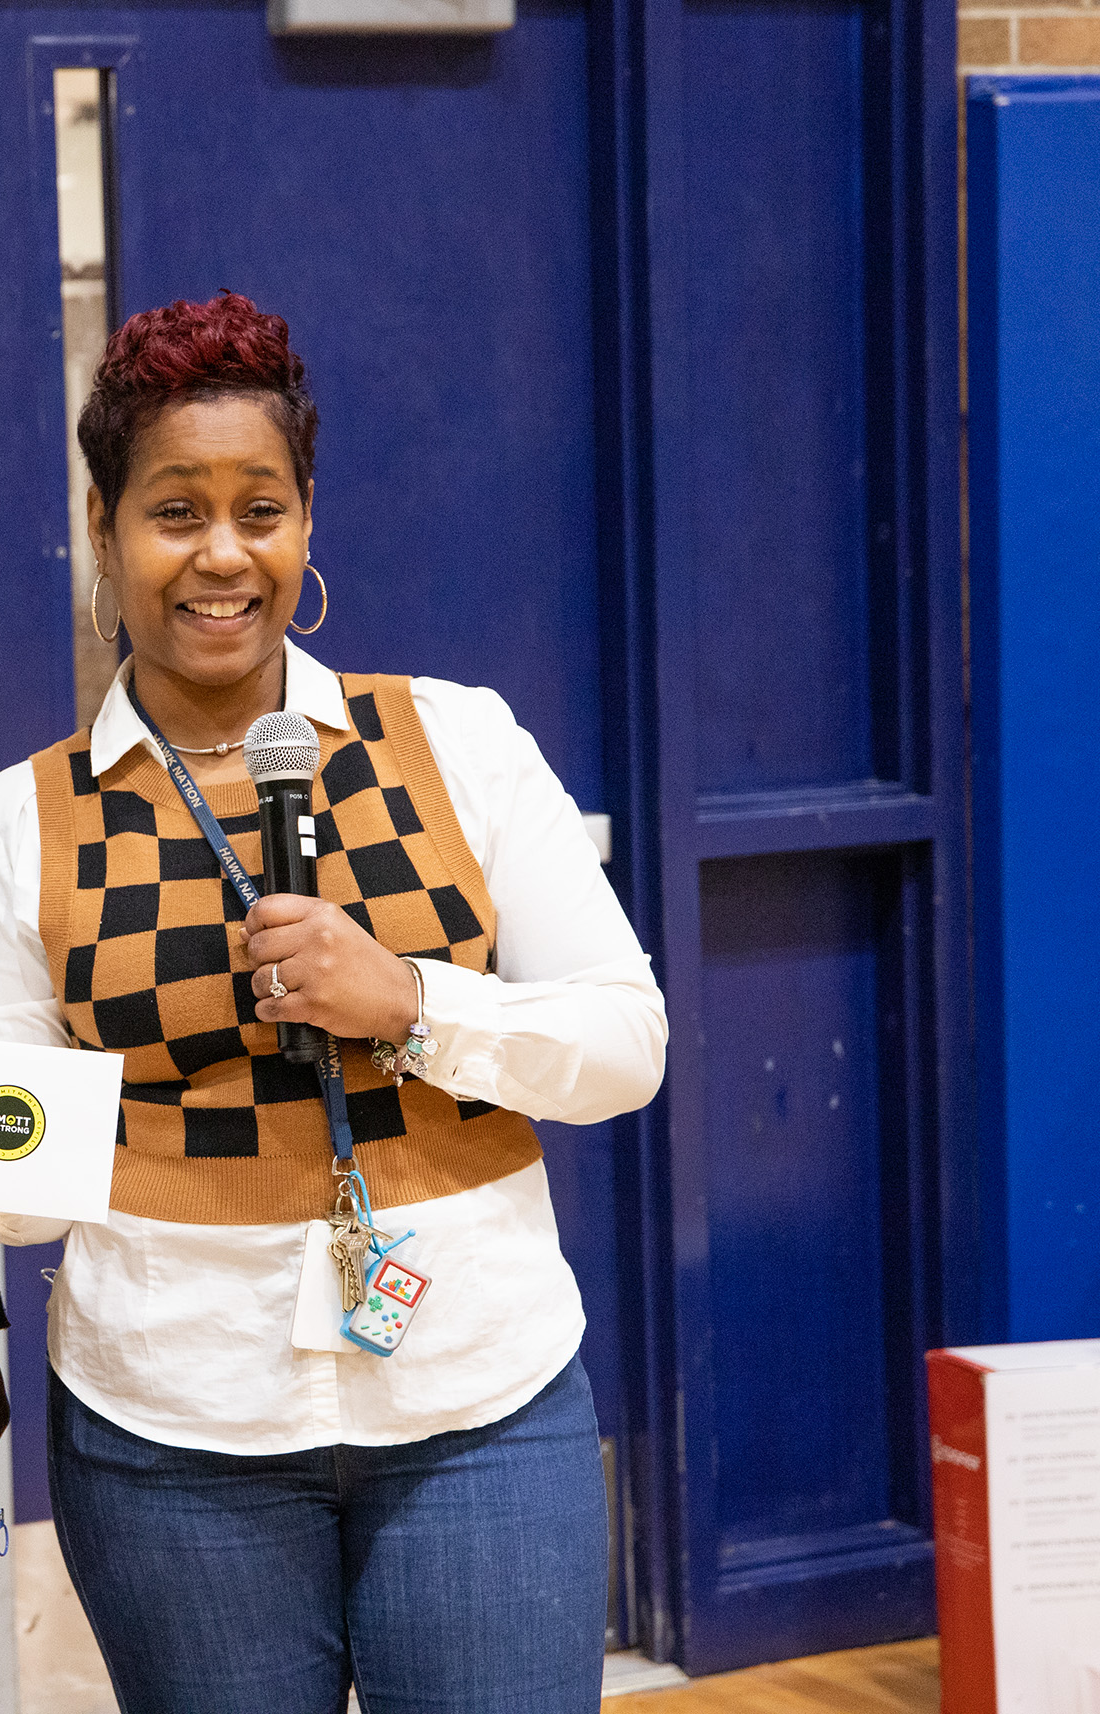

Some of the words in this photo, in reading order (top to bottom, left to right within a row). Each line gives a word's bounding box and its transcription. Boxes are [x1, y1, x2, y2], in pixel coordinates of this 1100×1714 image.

[153, 733, 178, 767] HAWK
[172, 764, 203, 809] NATION
[218, 846, 246, 883] HAWK
